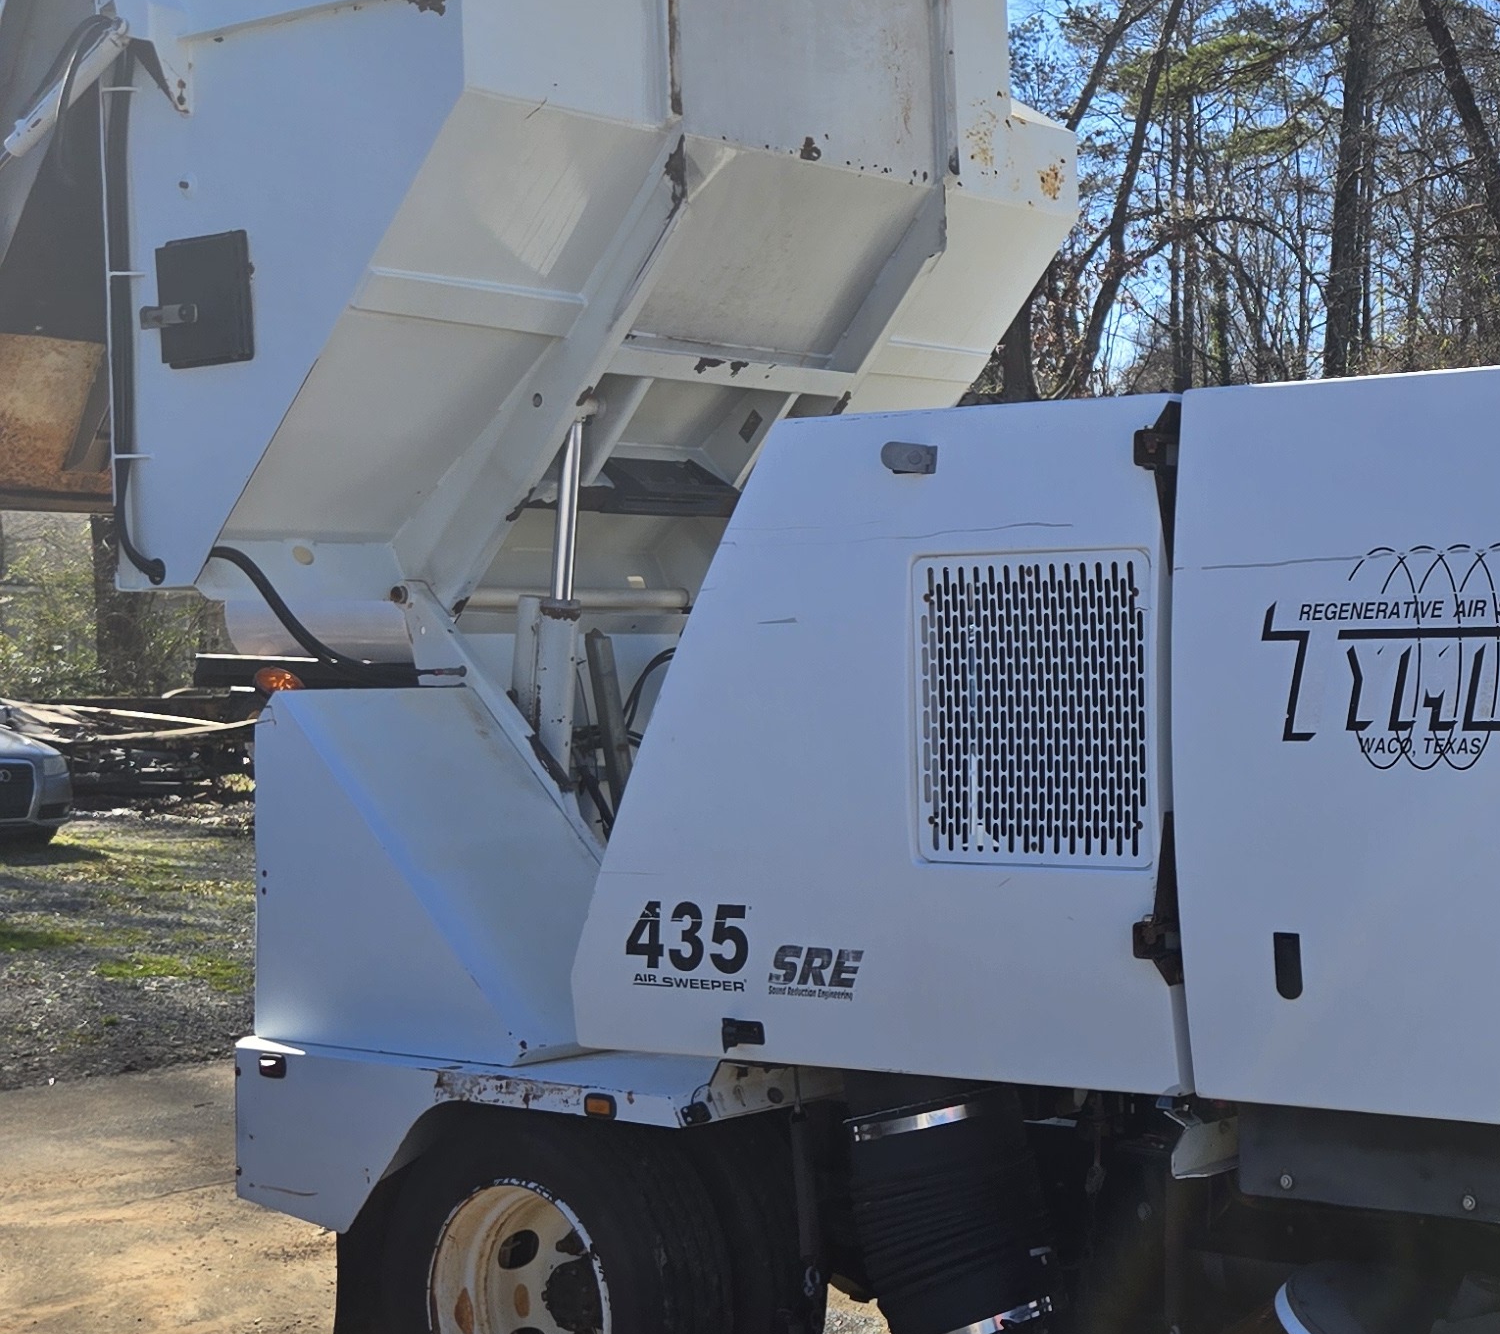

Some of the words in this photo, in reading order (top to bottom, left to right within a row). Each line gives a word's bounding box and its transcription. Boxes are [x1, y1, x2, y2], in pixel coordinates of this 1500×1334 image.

[1299, 601, 1444, 621] REGENERATIVE
[1453, 600, 1486, 618] AIR
[1360, 737, 1416, 757] WACO,
[1423, 737, 1481, 754] TEXAS
[626, 900, 749, 974] 435
[768, 945, 864, 988] SRE
[634, 973, 657, 982] AIR
[662, 977, 745, 992] SWEEPER
[768, 986, 786, 995] Sound
[787, 987, 816, 998] Reduction
[817, 989, 853, 1001] Engineering
